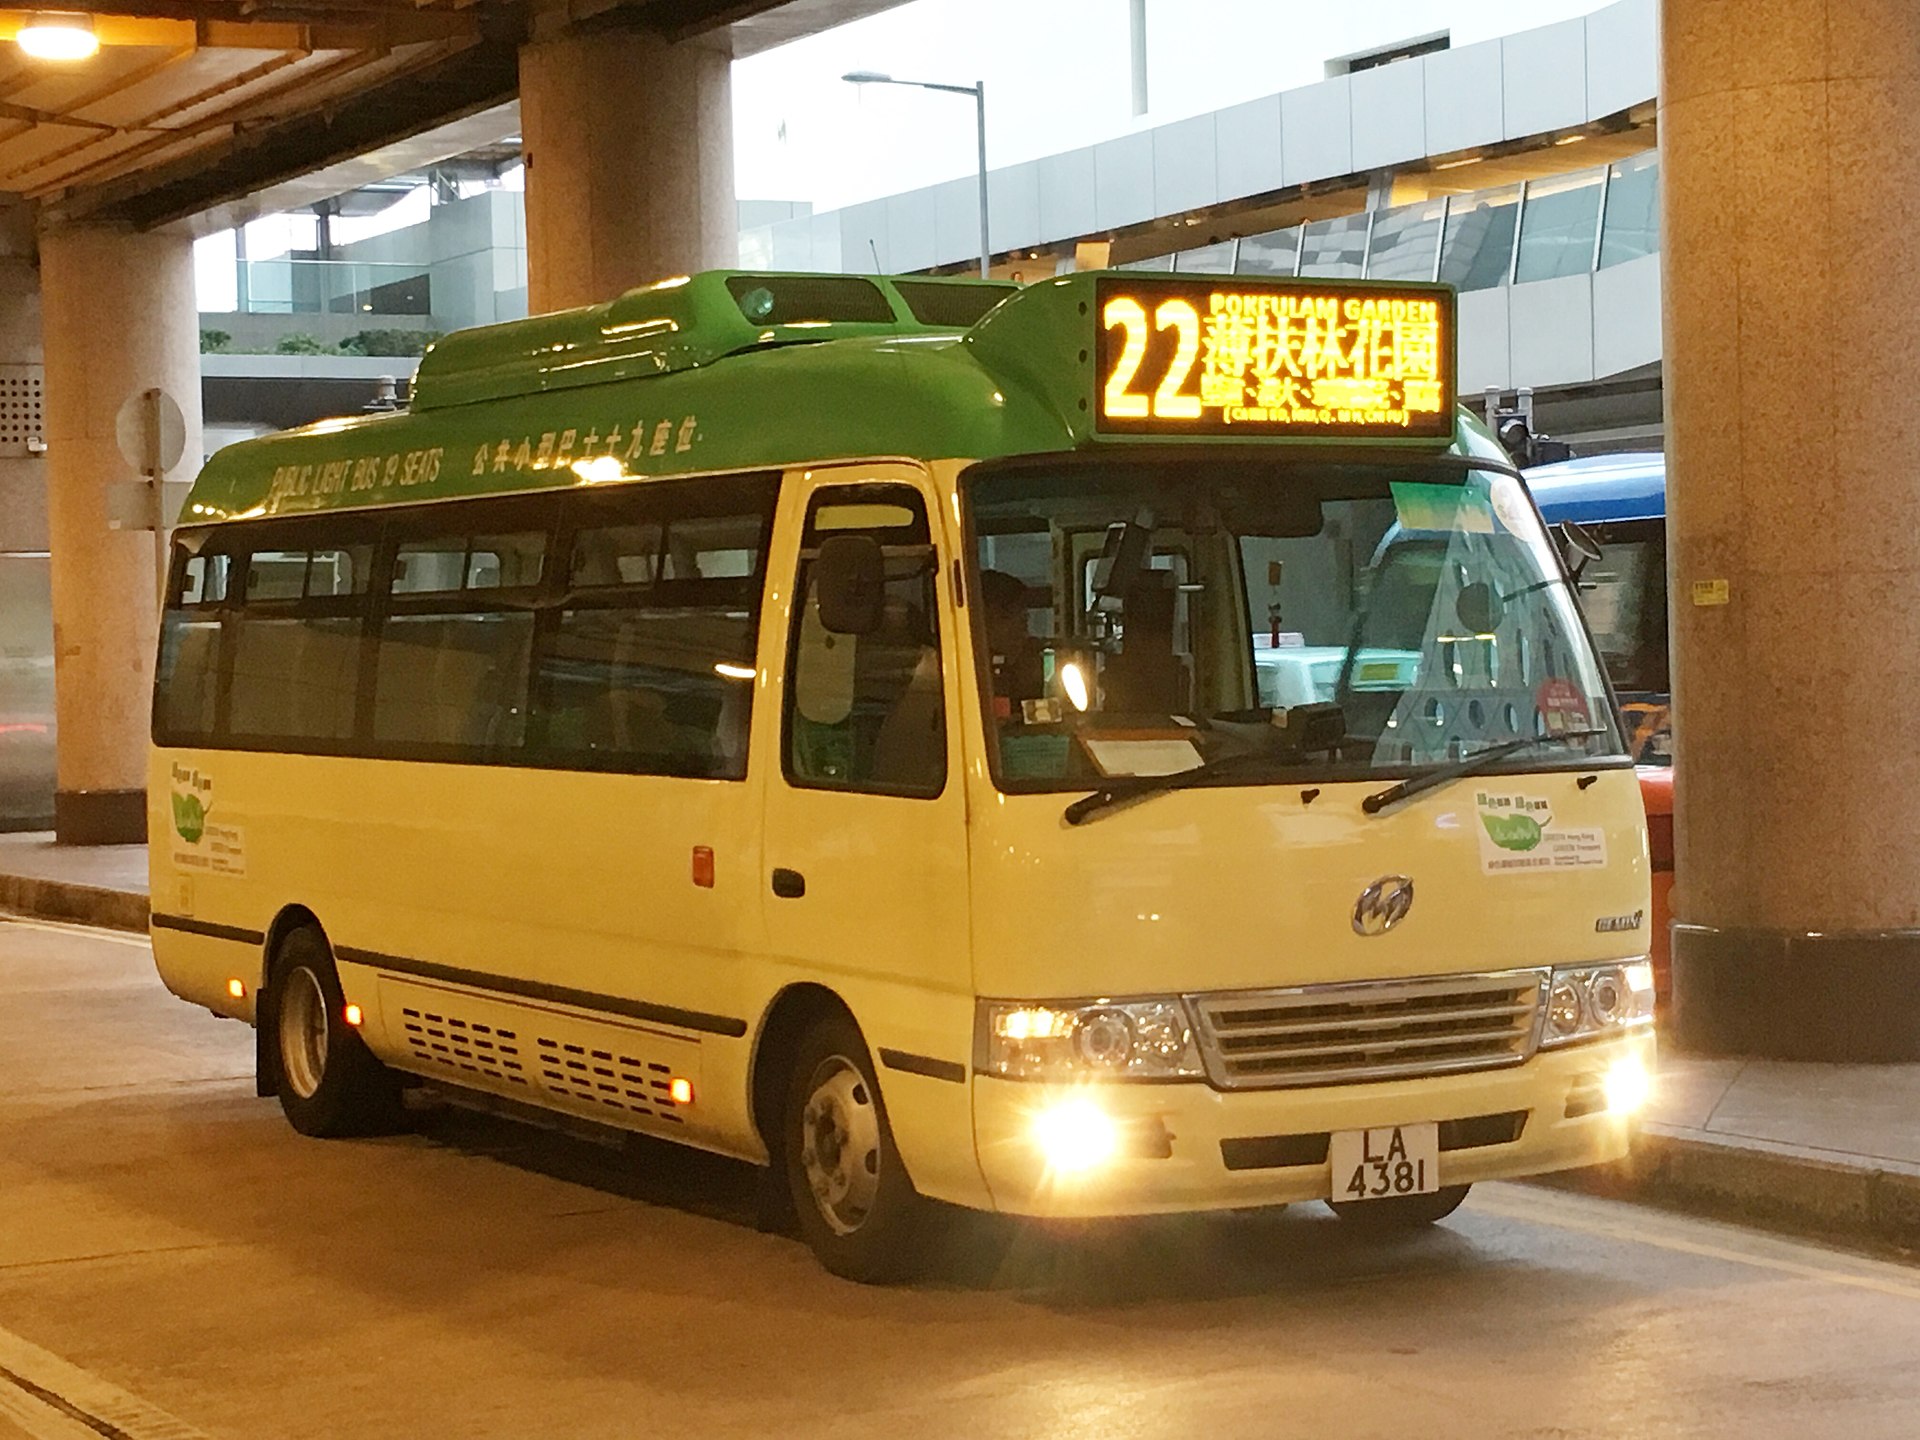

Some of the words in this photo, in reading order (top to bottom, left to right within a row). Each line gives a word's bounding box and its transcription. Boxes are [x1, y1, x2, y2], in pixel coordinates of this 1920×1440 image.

[1209, 293, 1338, 319] POKFULAM
[1343, 299, 1437, 322] GARDEN
[1103, 297, 1202, 418] 22
[1202, 315, 1438, 380] 薄扶林花園
[471, 415, 698, 476] 公共小型巴士十九座位
[270, 465, 312, 499] PUBLIC
[311, 460, 353, 495] LIGHT
[350, 457, 381, 492] BUS
[382, 453, 399, 487] 19
[400, 447, 444, 486] SEATS
[1363, 1127, 1407, 1163] LA
[1346, 1159, 1424, 1197] 4381
